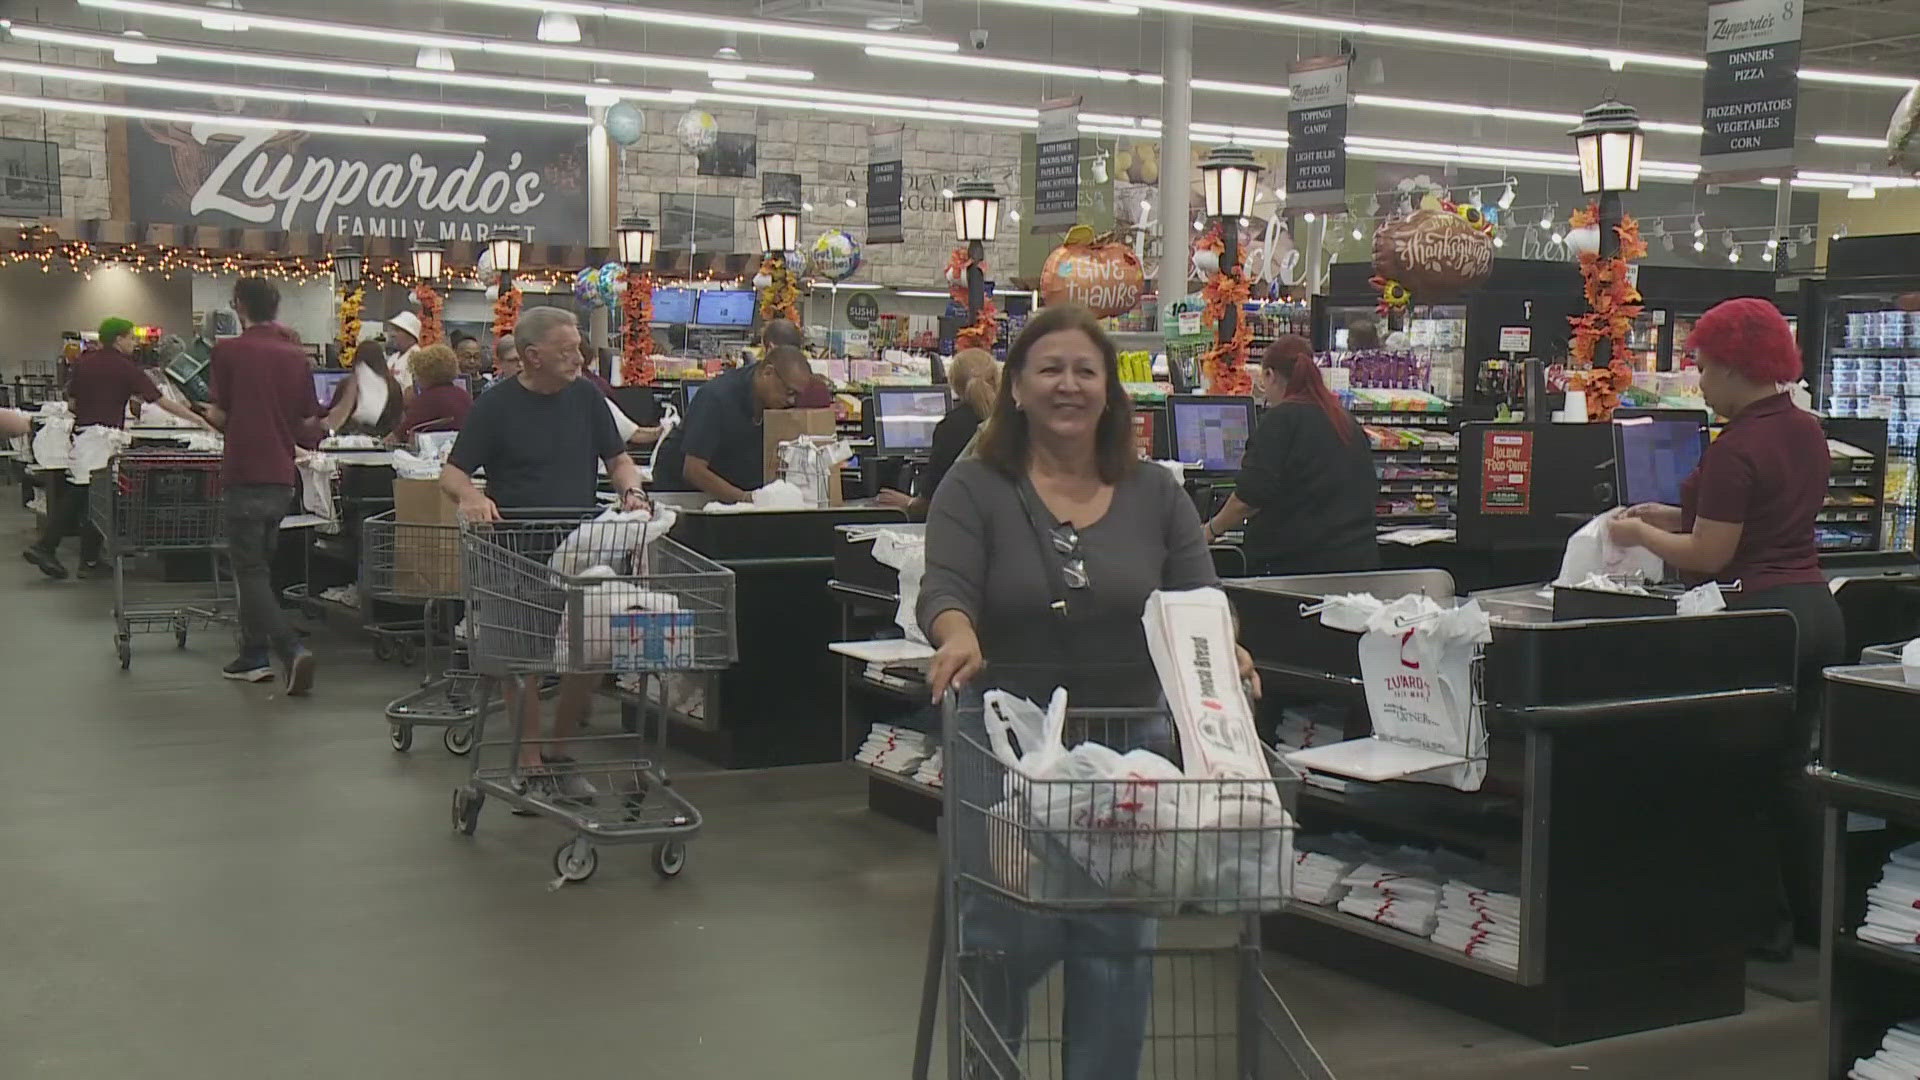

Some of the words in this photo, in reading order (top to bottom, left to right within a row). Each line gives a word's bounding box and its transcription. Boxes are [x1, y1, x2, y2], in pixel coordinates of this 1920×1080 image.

[1782, 0, 1794, 21] 8
[1712, 13, 1775, 40] Zuppardo's
[1729, 48, 1775, 66] DINNERS
[1734, 67, 1765, 82] PIZZA
[1301, 109, 1332, 122] TOPPINGS
[1706, 104, 1742, 119] FROZEN
[1743, 98, 1793, 115] POTATOES
[1304, 124, 1328, 135] CANDY
[1716, 117, 1780, 134] VEGETABLES
[1730, 136, 1761, 149] CORN
[1295, 151, 1315, 163] LIGHT
[1315, 149, 1336, 161] BULBS
[190, 121, 545, 235] Zuppardo's
[1299, 166, 1311, 177] PET
[1311, 165, 1331, 175] FOOD
[1296, 181, 1307, 191] ICE
[1308, 178, 1332, 189] CREAM
[438, 221, 536, 244] MART
[1521, 221, 1574, 262] fres
[1400, 227, 1491, 275] Thanksgiving
[1076, 259, 1125, 281] GIVE
[1066, 282, 1138, 308] THANKS
[849, 305, 876, 317] SUSHI
[1493, 446, 1521, 460] HOLIDAY
[1485, 458, 1506, 471] FOOD
[1506, 459, 1529, 472] DRIVE
